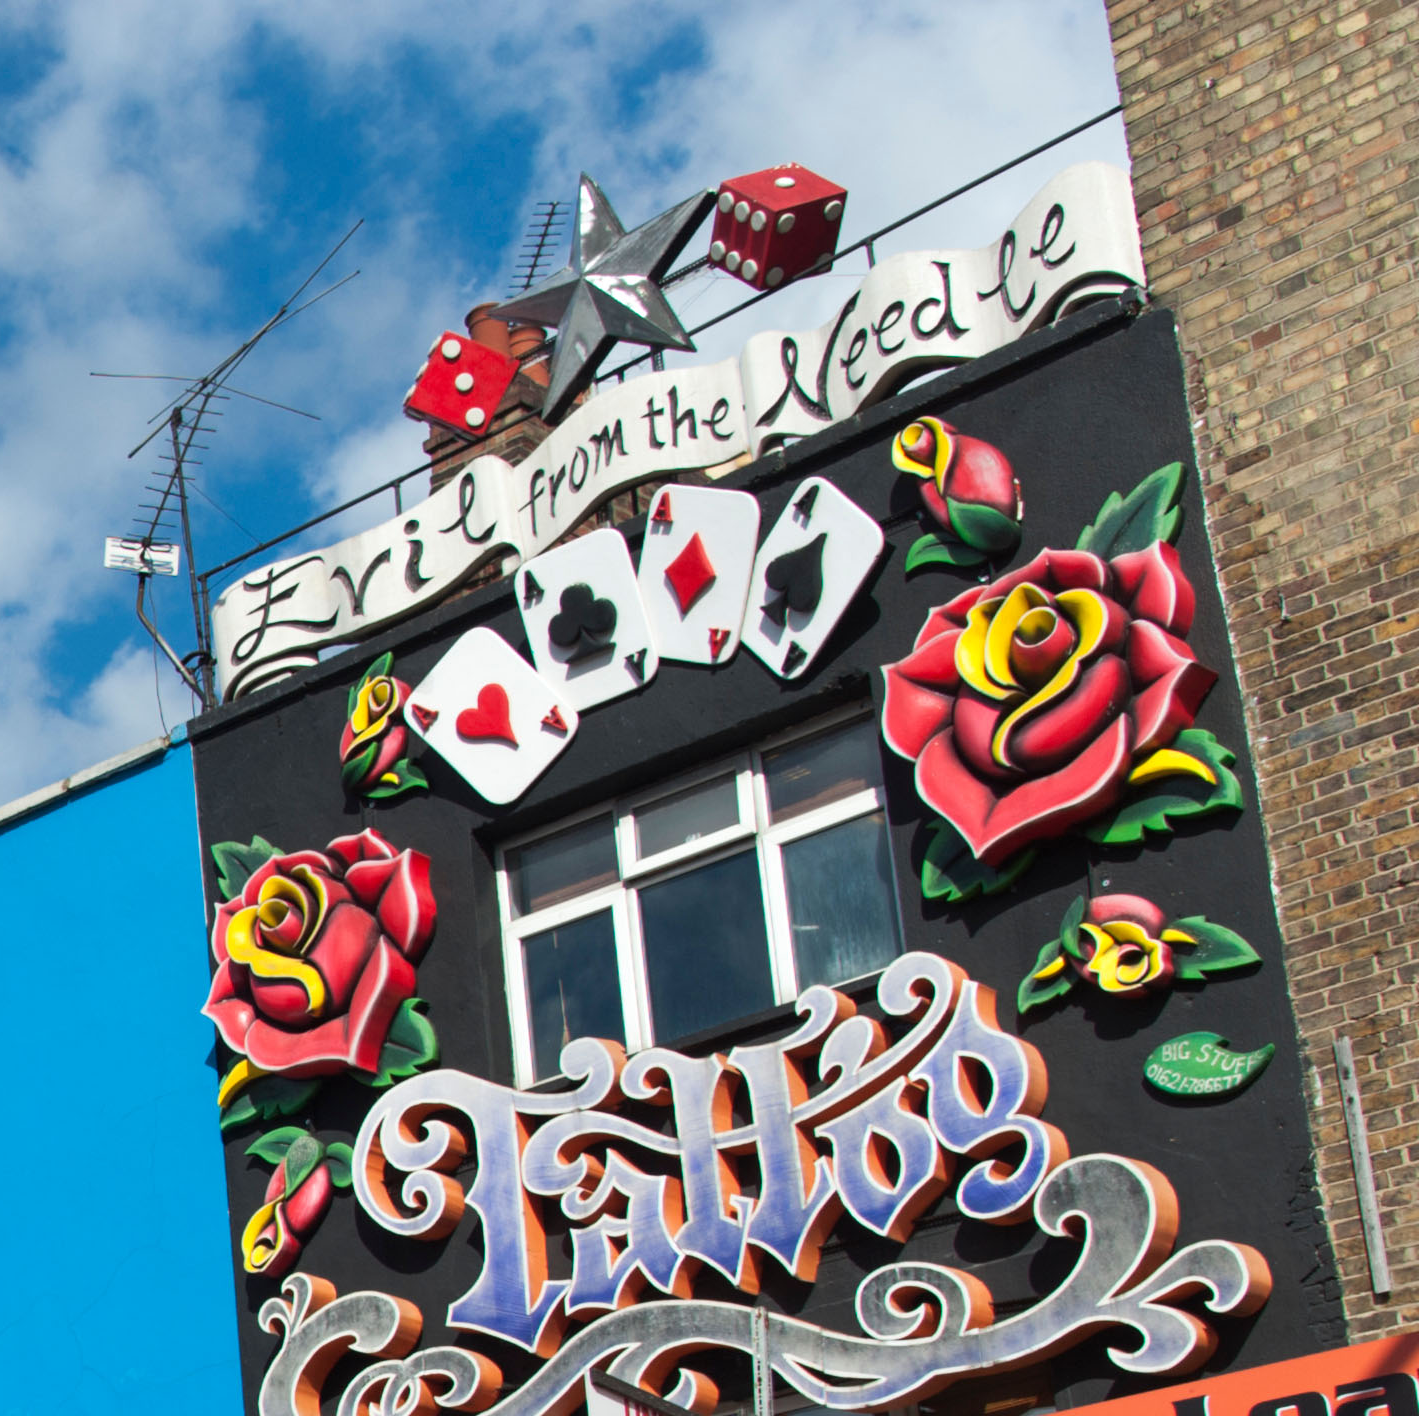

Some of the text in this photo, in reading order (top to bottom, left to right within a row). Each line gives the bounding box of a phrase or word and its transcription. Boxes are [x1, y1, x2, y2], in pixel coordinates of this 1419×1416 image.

[231, 203, 1075, 663] Evil from the Needle
[1162, 1041, 1259, 1074] BIG STUFF
